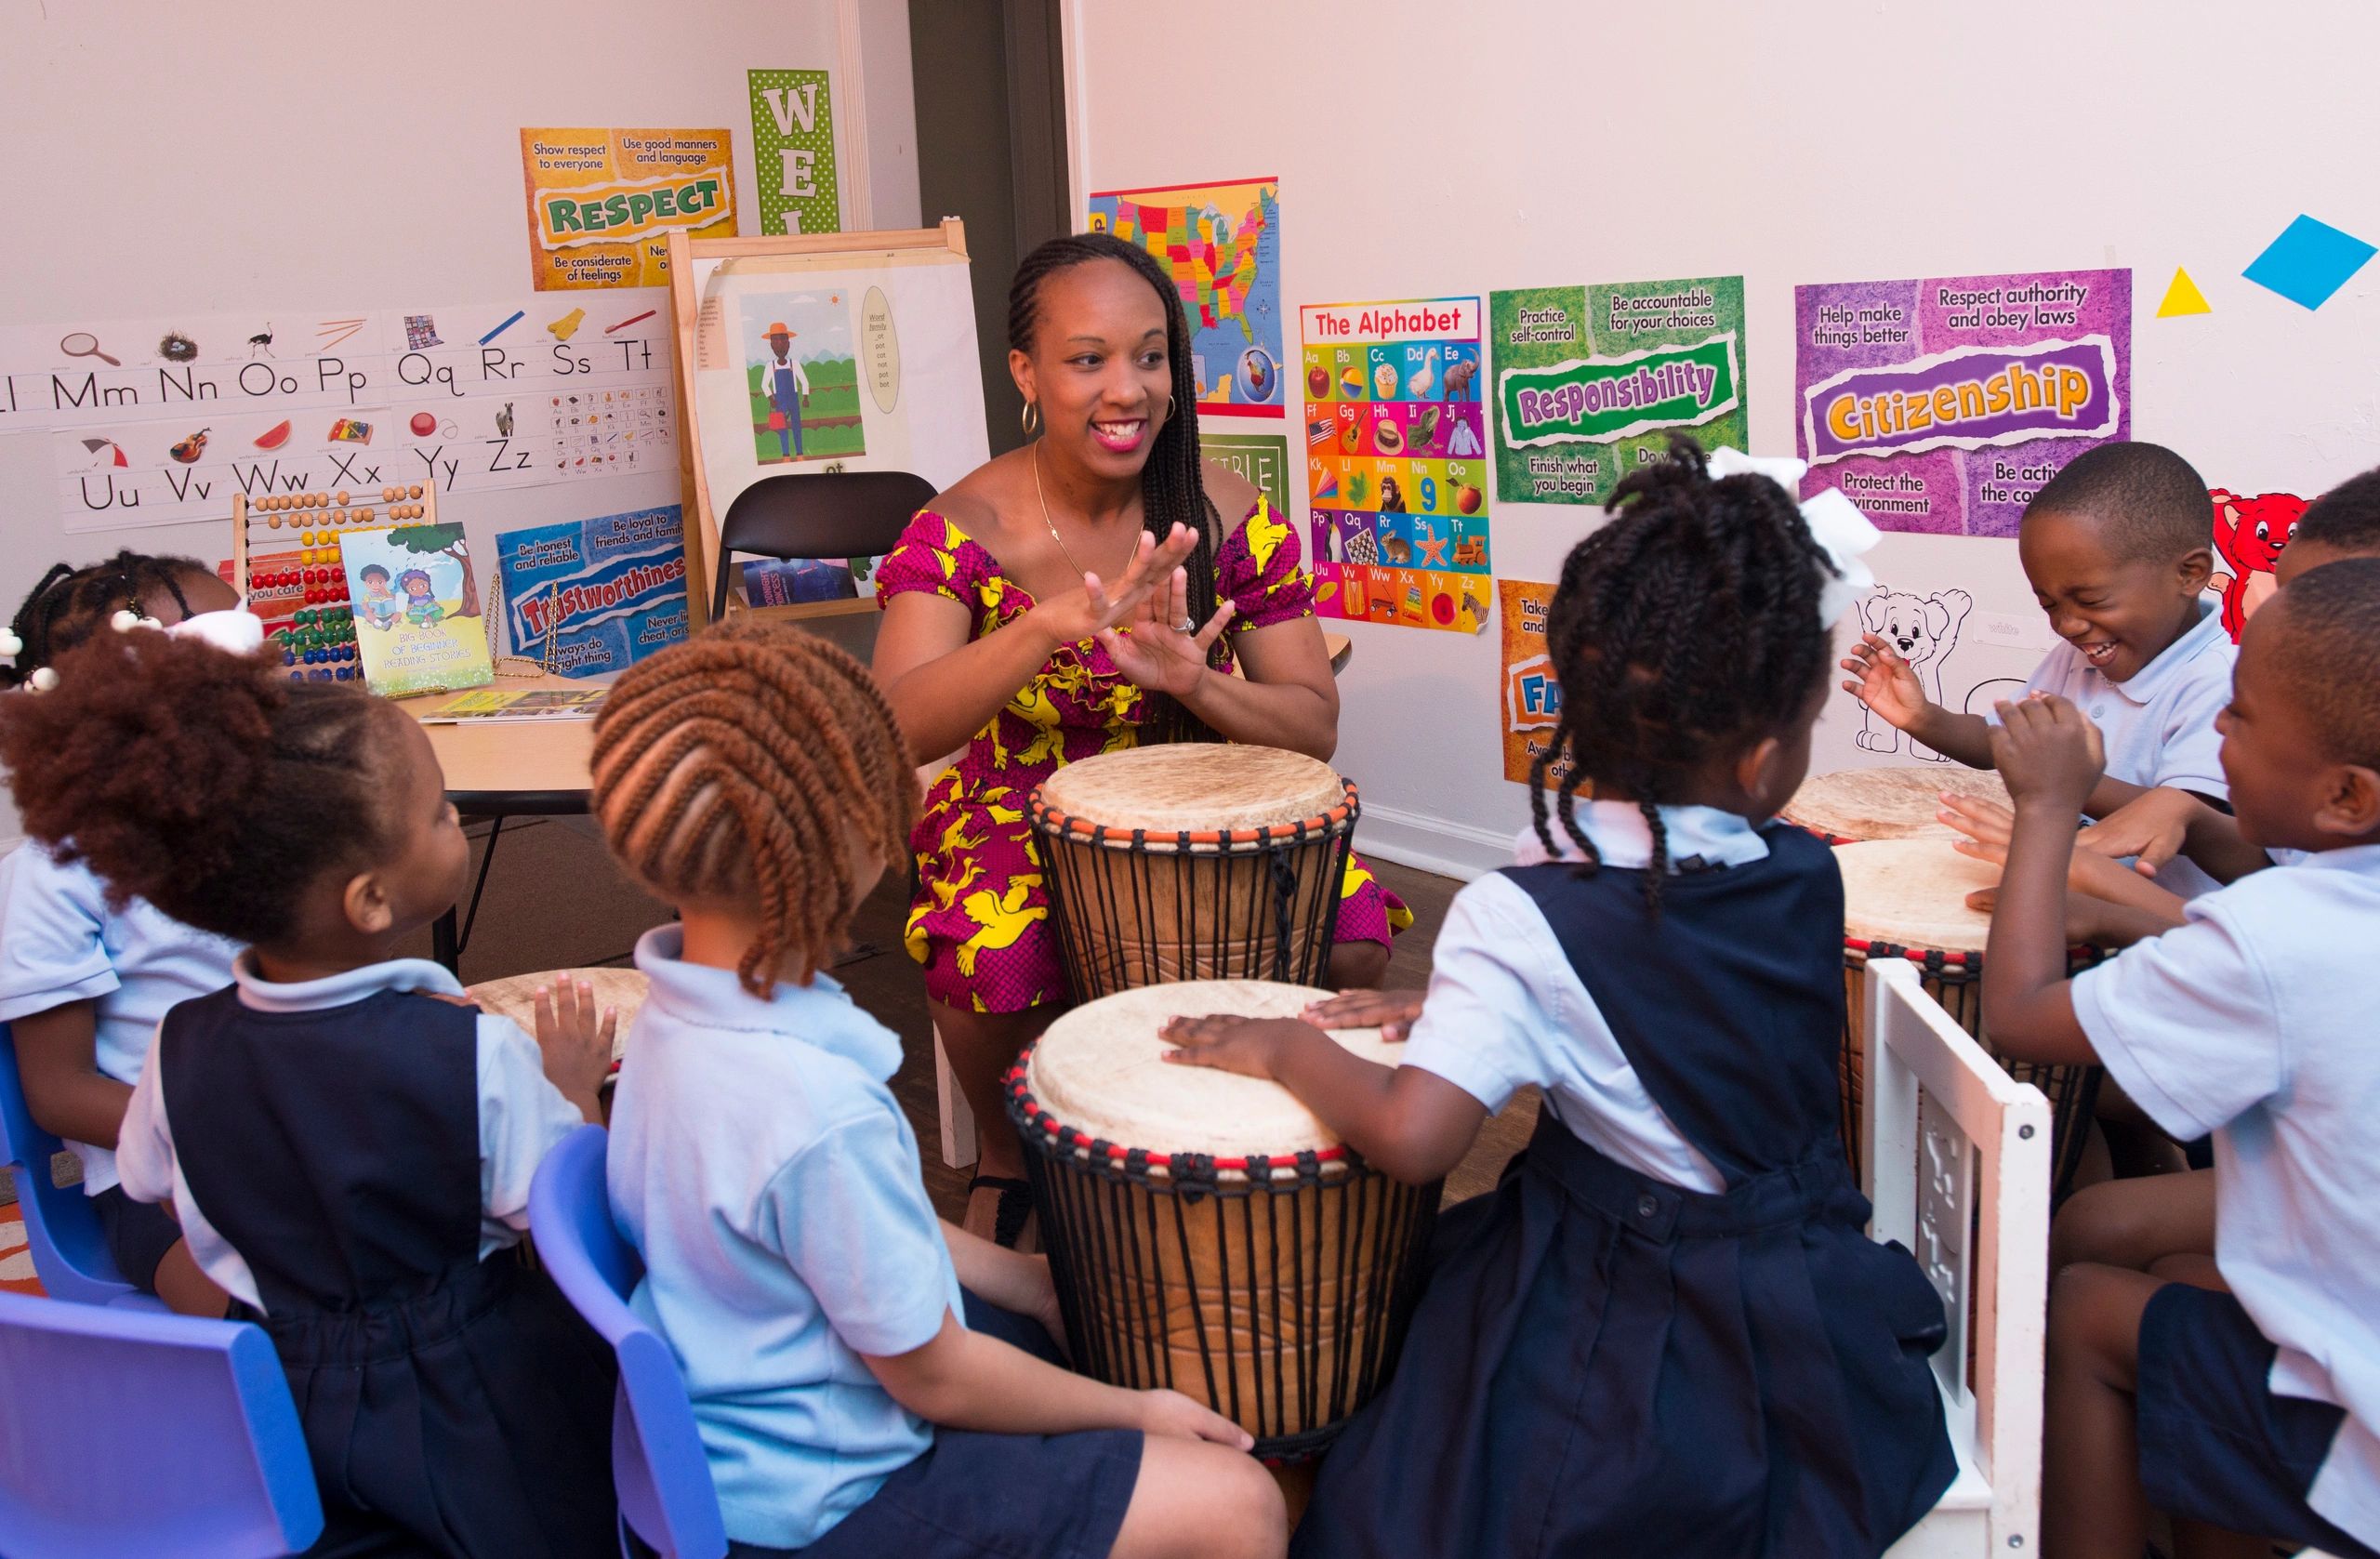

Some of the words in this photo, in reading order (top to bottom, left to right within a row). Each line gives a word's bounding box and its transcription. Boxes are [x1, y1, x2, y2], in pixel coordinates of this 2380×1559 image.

[534, 143, 563, 155] Show
[567, 144, 606, 158] respect
[623, 139, 642, 149] Use
[645, 139, 671, 152] good
[674, 139, 717, 149] manners
[539, 158, 551, 168] to
[554, 160, 603, 172] everyone
[637, 153, 656, 163] and
[659, 152, 707, 165] language
[548, 179, 718, 232] RESPECT
[554, 258, 569, 268] Be
[572, 256, 631, 267] considerate
[567, 271, 579, 281] of
[582, 270, 622, 282] feelings
[1613, 297, 1628, 310] Be
[1633, 290, 1712, 310] accountable
[1940, 288, 2002, 310] Respect
[2006, 283, 2087, 307] authority
[1316, 313, 1350, 336] The
[1358, 308, 1461, 339] Alphabet
[1520, 308, 1565, 324] Practice
[1610, 313, 1628, 330] for
[1633, 318, 1663, 334] your
[1666, 310, 1714, 327] choices
[1820, 308, 1854, 326] Help
[1859, 304, 1901, 322] make
[1949, 311, 1980, 328] and
[1986, 310, 2028, 331] obey
[2034, 309, 2075, 324] laws
[1512, 325, 1574, 342] self-control
[1814, 326, 1858, 349] things
[1863, 325, 1909, 344] better
[1305, 351, 1318, 363] Aa
[1337, 350, 1350, 363] Bb
[1370, 349, 1384, 362] Cc
[1407, 347, 1423, 361] Dd
[1445, 346, 1459, 360] Ee
[52, 373, 138, 409] Mm
[160, 367, 218, 402] Nn
[239, 363, 298, 396] Oo
[318, 358, 366, 403] Pp
[398, 353, 465, 396] Qq
[482, 348, 525, 380] Rr
[552, 344, 591, 375] Ss
[614, 339, 652, 371] Tt
[1519, 363, 1715, 424] Responsibility
[1829, 363, 2089, 441] Citizenship
[1307, 404, 1316, 416] Ff
[1340, 405, 1354, 420] Gg
[1374, 404, 1389, 417] Hh
[1446, 404, 1455, 421] Jj
[1639, 448, 1657, 462] Do
[1310, 458, 1322, 470] Kk
[1377, 460, 1396, 473] Mm
[1411, 459, 1427, 474] Nn
[1448, 462, 1465, 476] Oo
[1530, 457, 1564, 473] Finish
[1567, 457, 1597, 473] what
[1996, 463, 2016, 480] Be
[82, 474, 139, 509] Uu
[165, 468, 211, 502] Vv
[232, 459, 308, 495] Ww
[328, 453, 381, 487] Xx
[415, 445, 459, 492] Yy
[486, 440, 532, 471] Zz
[1844, 472, 1895, 490] Protect
[1899, 472, 1924, 491] the
[1421, 477, 1436, 511] 9
[1535, 480, 1555, 495] you
[1559, 477, 1594, 495] begin
[1981, 482, 2007, 502] the
[2013, 491, 2038, 502] co
[1848, 494, 1929, 513] vironment
[614, 522, 626, 532] Be
[629, 515, 654, 531] loyal
[656, 515, 667, 524] to
[1313, 510, 1325, 524] Pp
[1345, 513, 1361, 529] Qq
[1380, 515, 1391, 528] Rr
[1415, 517, 1427, 530] Ss
[1451, 519, 1462, 533] Tt
[520, 546, 533, 556] Be
[536, 538, 572, 552] honest
[595, 534, 630, 548] friends
[633, 530, 653, 541] and
[515, 558, 536, 570] and
[539, 549, 578, 565] reliable
[1316, 563, 1329, 576] Uu
[1342, 566, 1355, 578] Vv
[1370, 568, 1390, 582] Ww
[1399, 571, 1414, 584] Xx
[1430, 574, 1443, 588] Yy
[1461, 576, 1475, 588] Zz
[1522, 600, 1548, 615] Take
[648, 614, 677, 628] Never
[1523, 618, 1544, 632] and
[399, 633, 416, 642] BIG
[418, 628, 447, 640] BOOK
[588, 638, 602, 650] do
[639, 631, 668, 643] cheat,
[383, 655, 426, 668] READING
[430, 649, 470, 663] STORIES
[391, 646, 405, 655] OF
[559, 655, 584, 670] right
[585, 652, 611, 662] thing
